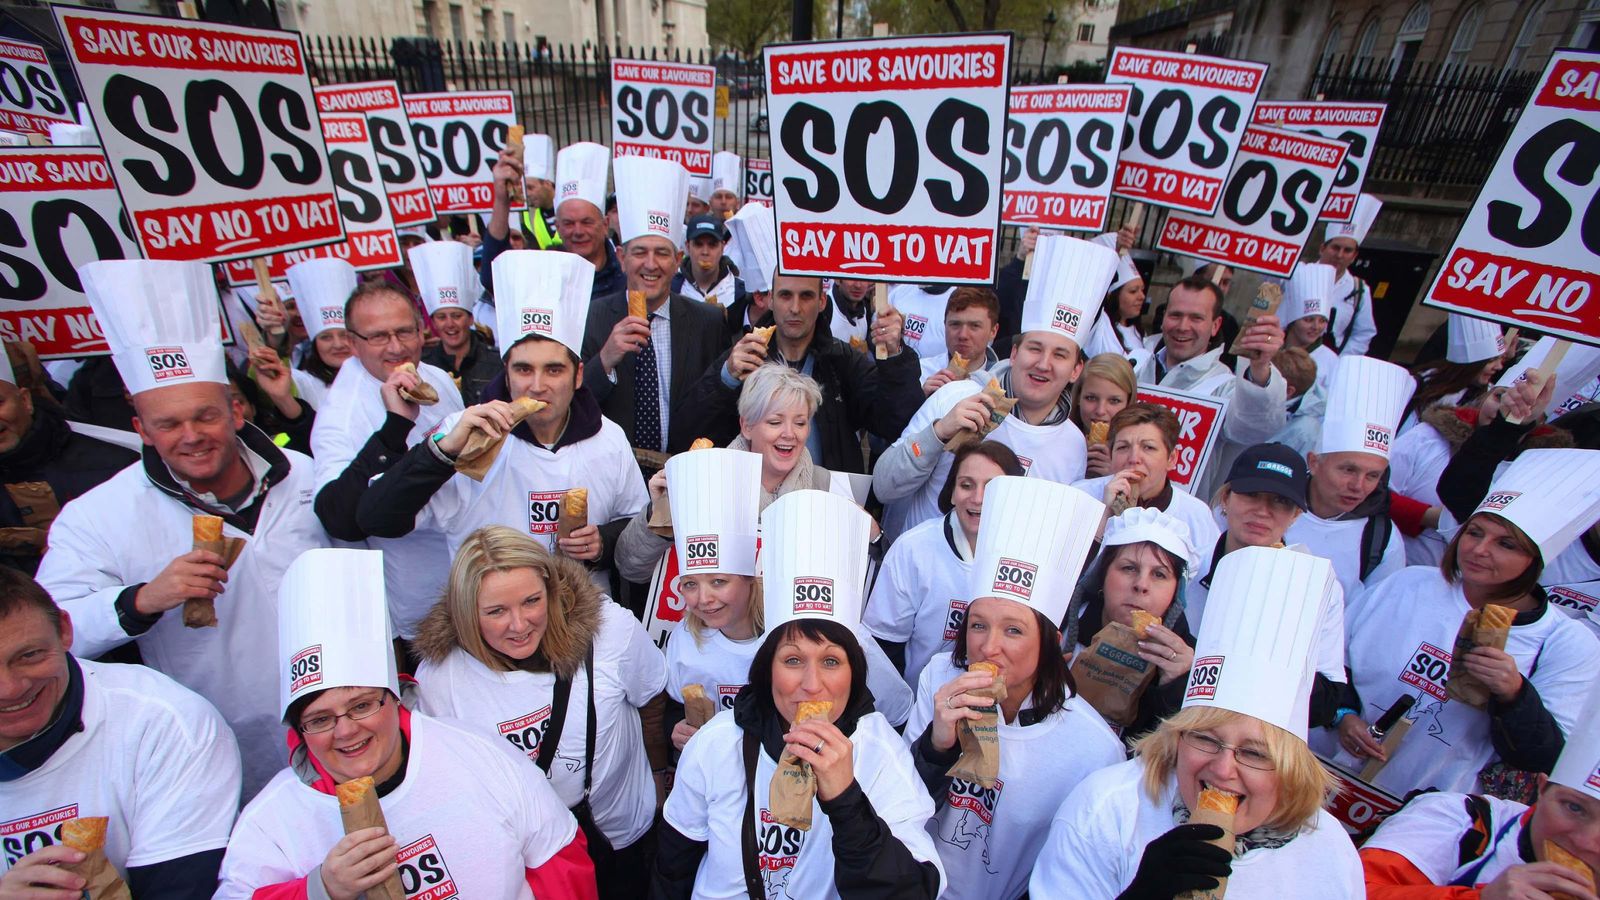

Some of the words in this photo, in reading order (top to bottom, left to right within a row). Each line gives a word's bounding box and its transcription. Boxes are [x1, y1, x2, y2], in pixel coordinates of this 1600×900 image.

[0, 44, 43, 60] AVOURIES
[80, 26, 144, 56] SAVE
[149, 32, 194, 60] OUR
[200, 37, 298, 69] SAVOURIES
[617, 66, 640, 79] SAVE
[641, 67, 659, 80] OUR
[661, 70, 711, 84] SAVOURIES
[778, 59, 827, 85] SAVE
[832, 57, 872, 83] OUR
[878, 52, 996, 81] SAVOURIES
[1118, 56, 1150, 75] SAVE
[1152, 61, 1179, 78] OUR
[1181, 65, 1256, 89] SAVOURIES
[0, 61, 66, 115] OS
[1555, 69, 1600, 100] SA
[320, 90, 394, 111] SAVOURIES
[430, 100, 451, 113] OUR
[453, 98, 509, 113] SAVOURIES
[1009, 95, 1027, 109] AVE
[1030, 93, 1055, 109] OUR
[1057, 93, 1123, 109] SAVOURIES
[12, 113, 31, 128] NO
[617, 85, 709, 144] SOS
[1258, 108, 1286, 121] SAVE
[1288, 109, 1311, 122] OUR
[1315, 109, 1378, 123] SAVOURIES
[103, 74, 322, 197] SOS
[323, 121, 362, 138] URIES
[411, 119, 508, 179] SOS
[780, 98, 990, 217] SOS
[1004, 118, 1114, 188] SOS
[1242, 131, 1267, 148] OUR
[1269, 138, 1339, 163] SAVOURIES
[685, 150, 710, 168] VAT
[747, 170, 773, 197] SO
[1122, 167, 1147, 187] NO
[1153, 172, 1176, 193] TO
[1182, 177, 1219, 202] VAT
[392, 191, 428, 215] VAT
[448, 189, 469, 203] NO
[471, 187, 492, 202] TO
[1223, 159, 1322, 236] OS
[1015, 196, 1039, 214] NO
[1043, 197, 1064, 215] TO
[1069, 199, 1105, 220] VAT
[144, 213, 202, 249] SAY
[215, 208, 252, 240] NO
[256, 206, 291, 232] TO
[292, 200, 334, 230] VAT
[649, 215, 669, 228] SOS
[0, 198, 135, 301] SO
[353, 233, 393, 257] VAT
[786, 229, 835, 258] SAY
[843, 231, 880, 260] NO
[888, 233, 925, 262] TO
[934, 235, 989, 266] VAT
[1166, 221, 1203, 243] SAY
[1203, 231, 1231, 252] NO
[1236, 237, 1259, 258] TO
[1261, 243, 1298, 266] VAT
[440, 290, 457, 299] SOS
[1448, 257, 1529, 299] SAY
[1526, 275, 1591, 313] NO
[322, 311, 343, 320] SOS
[523, 313, 551, 325] SOS
[1055, 309, 1078, 327] SOS
[0, 313, 55, 343] SAY
[905, 319, 925, 334] SOS
[150, 354, 187, 370] SOS
[1176, 409, 1201, 440] UR
[1367, 429, 1388, 445] SOS
[1267, 462, 1293, 476] GREGGS
[531, 501, 560, 522] SO
[687, 543, 717, 559] SOS
[998, 566, 1033, 587] SOS
[796, 585, 831, 602] SOS
[292, 655, 319, 681] SOS
[1110, 650, 1145, 669] GREGGS
[1411, 653, 1449, 687] SO
[1191, 666, 1218, 686] SOS
[1403, 672, 1417, 682] SAY
[1428, 683, 1436, 691] TO
[1, 825, 14, 834] AVE
[16, 821, 30, 831] OUR
[32, 809, 76, 828] SAVOURIES
[398, 839, 433, 859] SAVOURIES
[771, 859, 781, 867] TO
[398, 853, 445, 895] OS
[419, 890, 433, 900] TO
[433, 883, 453, 898] VAT
